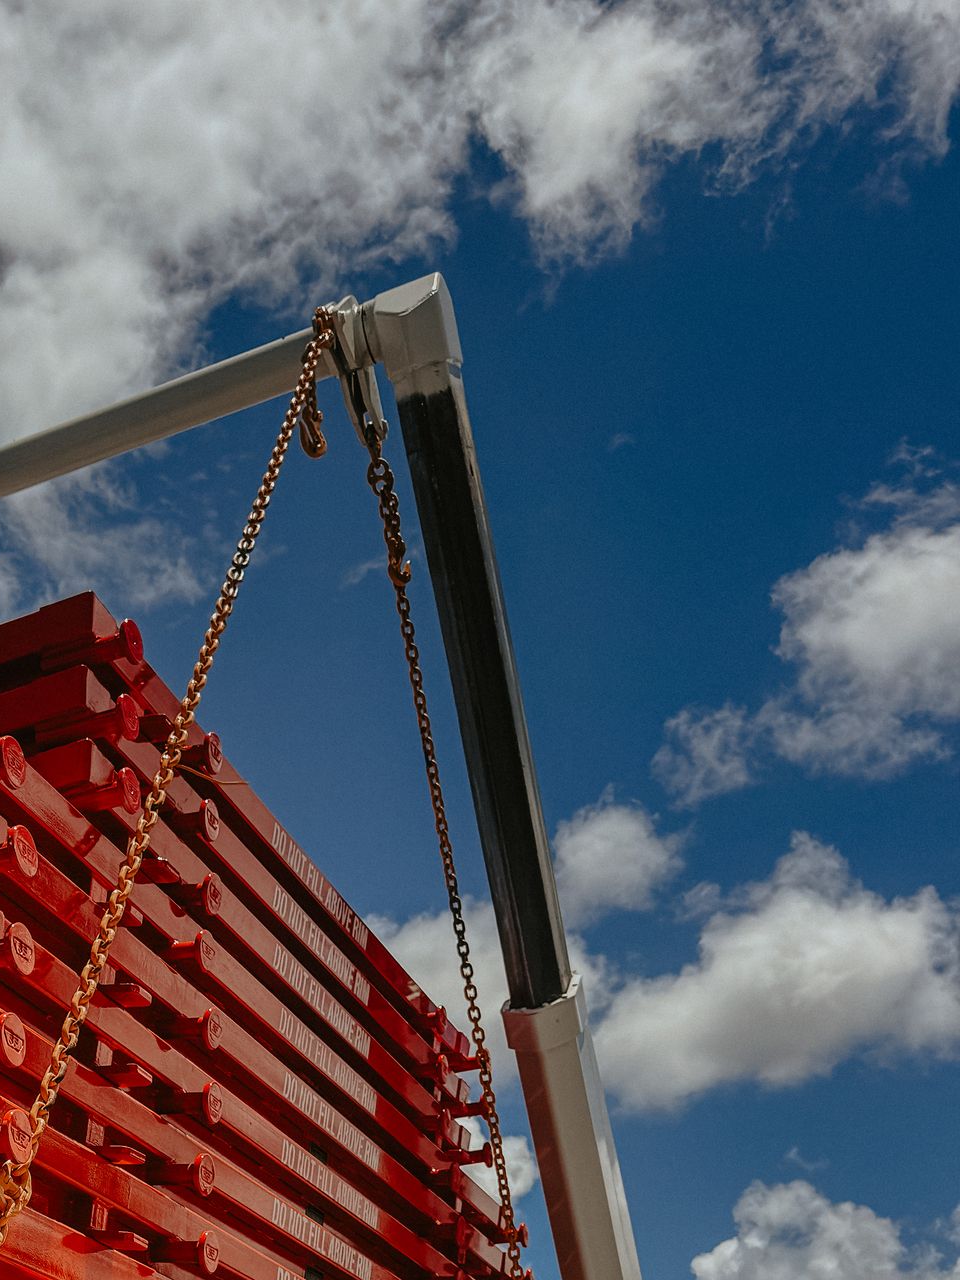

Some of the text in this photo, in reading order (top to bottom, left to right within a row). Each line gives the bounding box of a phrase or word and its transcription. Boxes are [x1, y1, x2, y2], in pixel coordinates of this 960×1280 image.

[272, 822, 368, 950] DO NOT FILL ABOVE RIM
[273, 885, 370, 1007] DO NOT FILL ABOVE RIM
[273, 943, 371, 1060] DO NOT FILL ABOVE RIM
[279, 1007, 377, 1116] DO NOT FILL ABOVE RIM
[283, 1071, 380, 1173] DO NOT FILL ABOVE RIM
[272, 1197, 287, 1229] DO
[288, 1208, 308, 1245] NOT
[308, 1221, 326, 1254] FILL
[328, 1236, 356, 1275] ABOVE
[281, 1138, 379, 1230] DO NOT FILL ABOVE RIM
